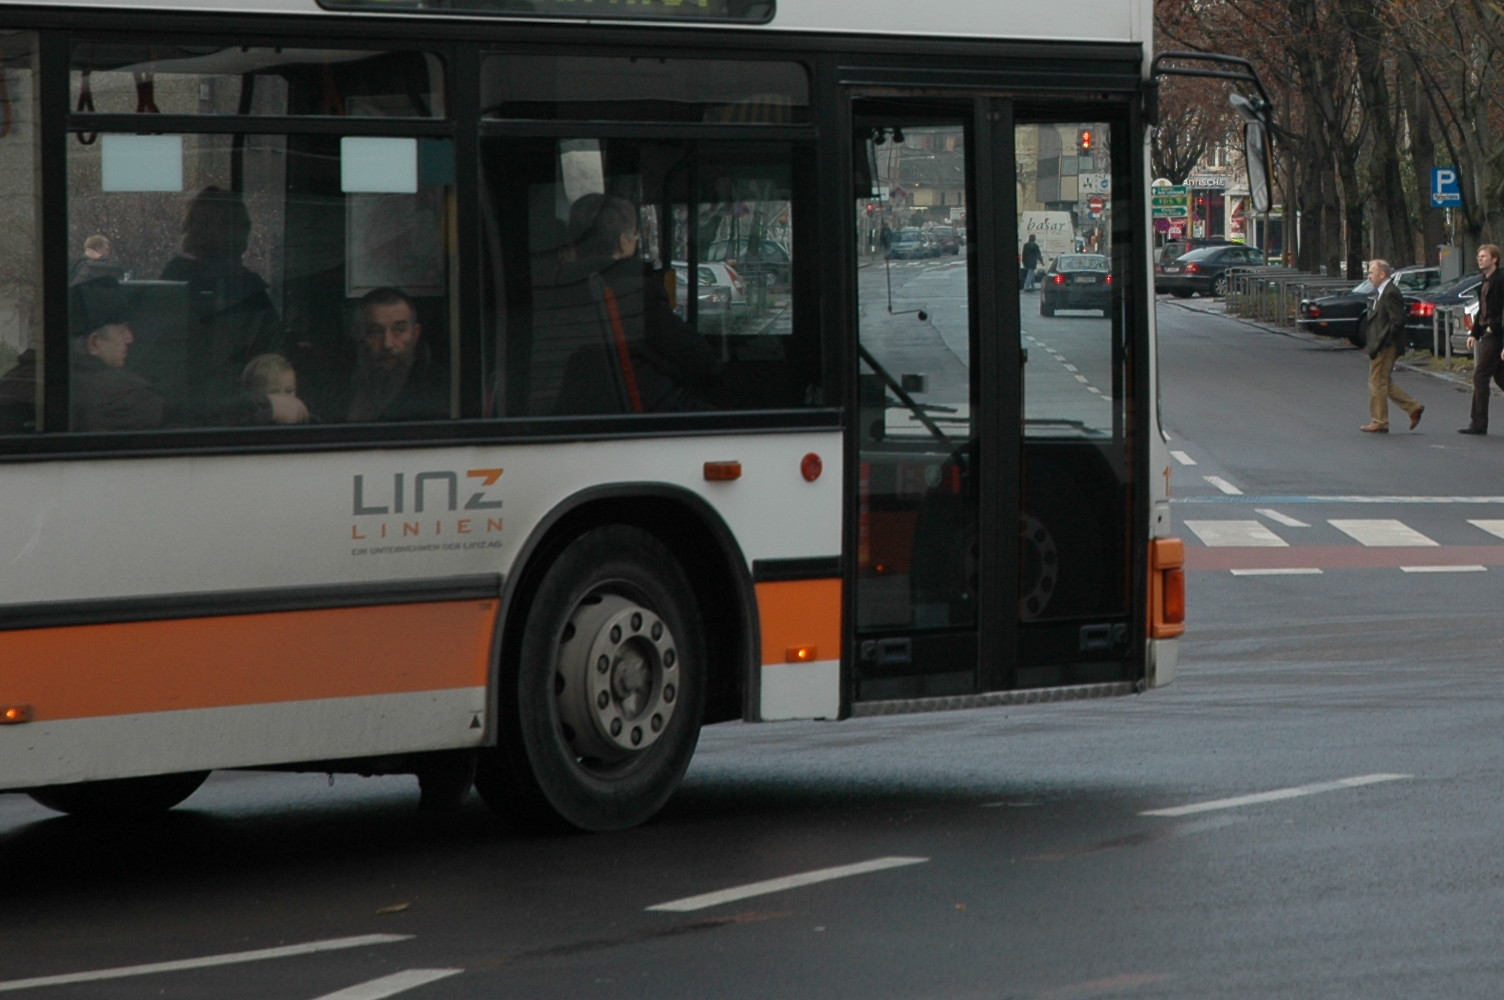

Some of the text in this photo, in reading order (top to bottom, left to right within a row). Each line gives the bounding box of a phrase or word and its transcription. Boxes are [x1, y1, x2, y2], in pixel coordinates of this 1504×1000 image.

[1436, 170, 1456, 195] P
[353, 468, 504, 515] LINZ
[352, 518, 504, 540] LINIEN
